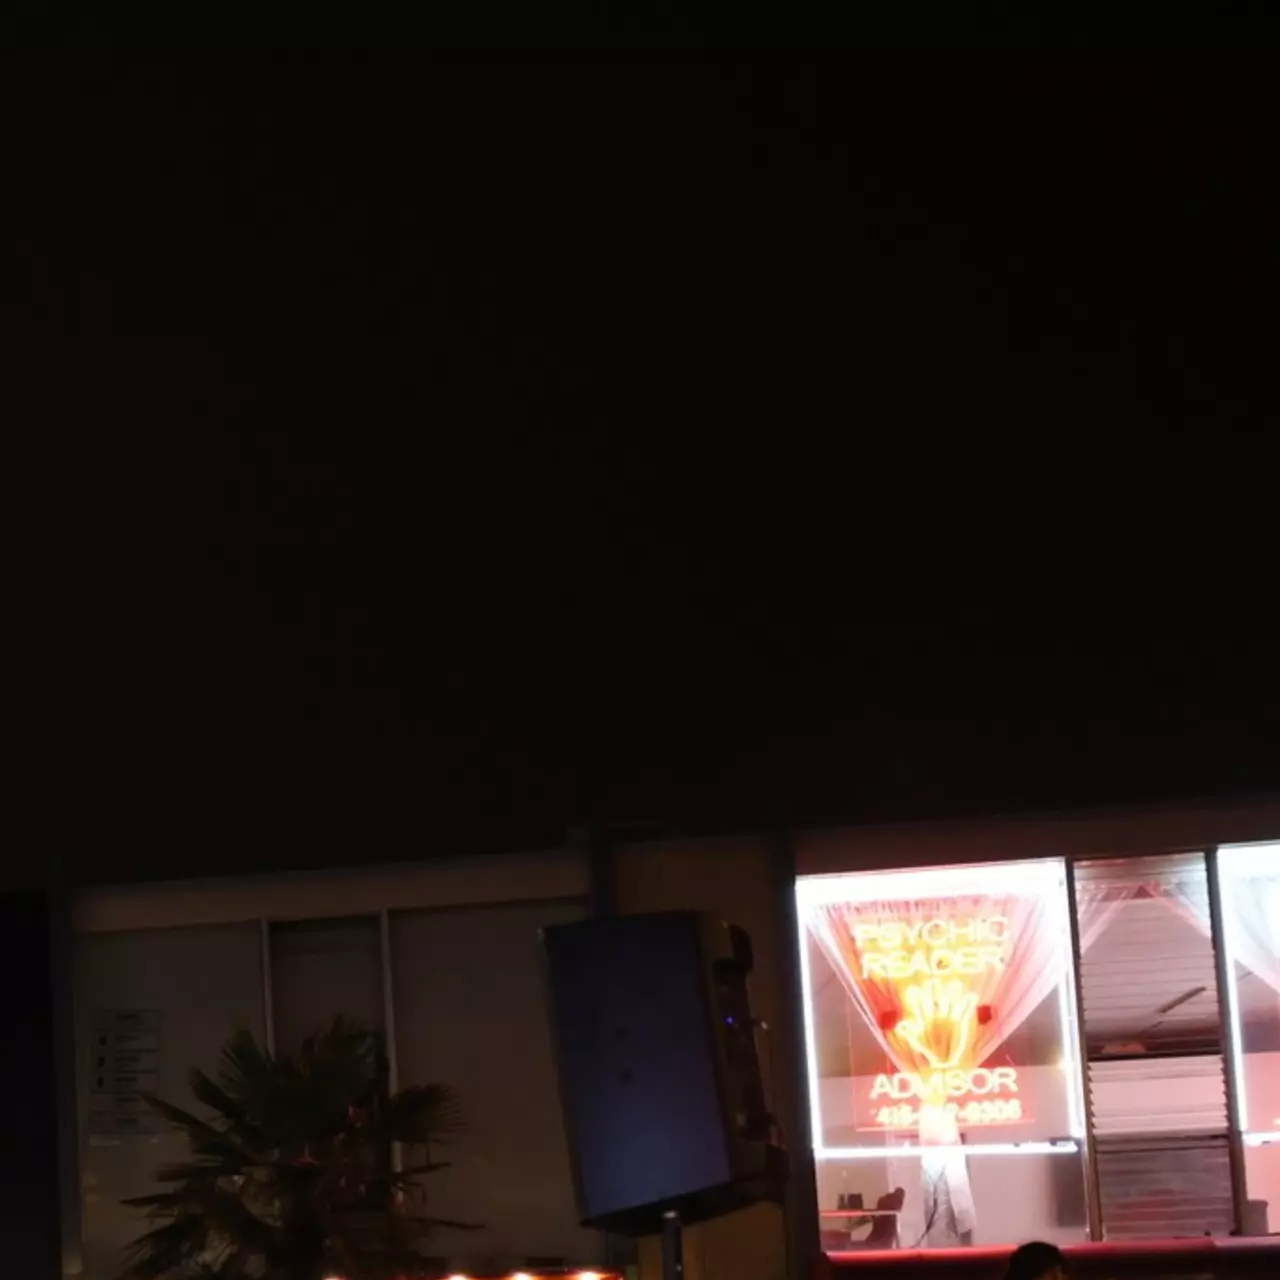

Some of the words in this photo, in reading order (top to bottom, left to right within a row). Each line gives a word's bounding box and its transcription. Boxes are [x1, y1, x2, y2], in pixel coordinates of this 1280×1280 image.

[852, 915, 1011, 949] PSYCHIC
[861, 946, 1005, 980] READER
[869, 1066, 1019, 1099] ADVISOR
